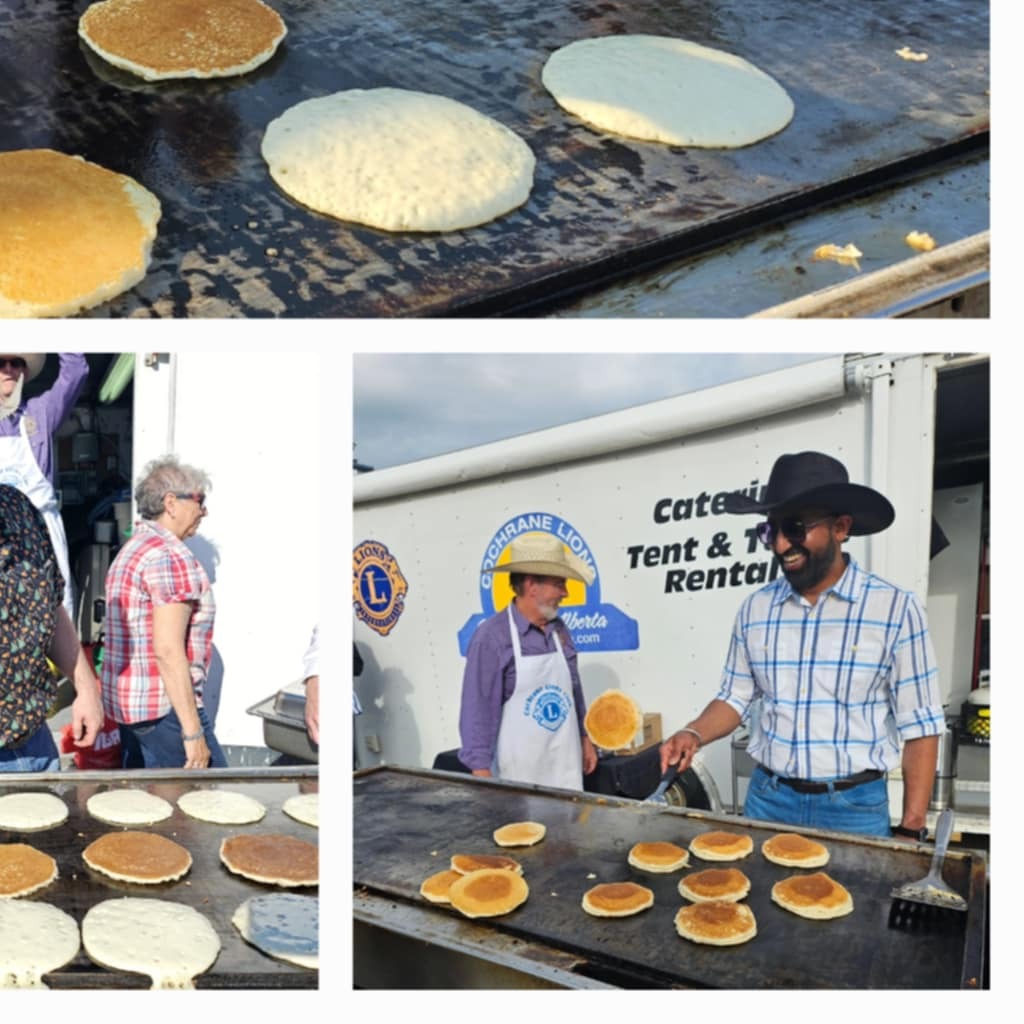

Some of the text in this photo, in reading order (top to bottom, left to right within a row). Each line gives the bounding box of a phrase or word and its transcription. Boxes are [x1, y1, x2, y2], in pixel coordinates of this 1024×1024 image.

[481, 514, 554, 590] COCHRANE
[627, 537, 699, 570] Tent
[706, 531, 732, 560] &
[364, 570, 388, 605] L
[664, 556, 780, 594] Rental
[573, 629, 601, 644] .com
